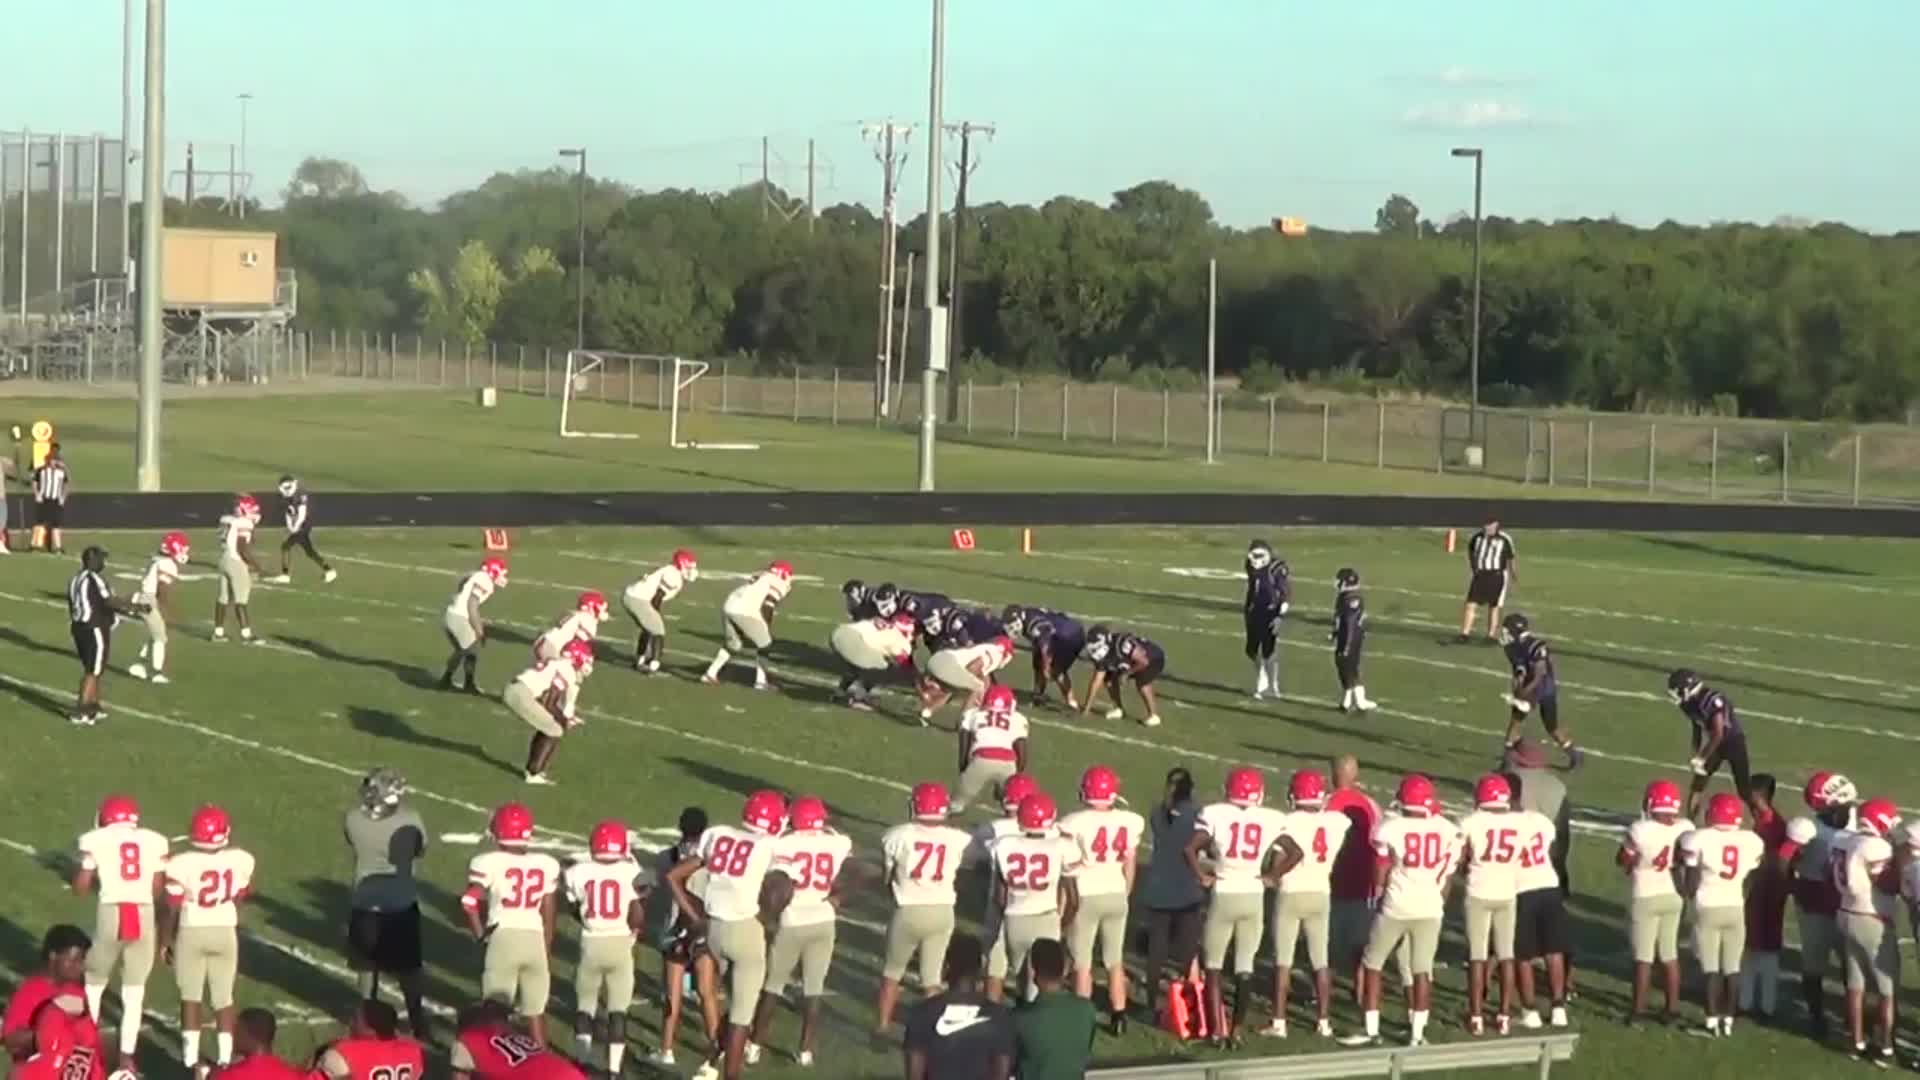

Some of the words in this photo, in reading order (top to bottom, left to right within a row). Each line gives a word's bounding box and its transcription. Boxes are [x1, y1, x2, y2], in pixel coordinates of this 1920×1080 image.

[707, 836, 754, 877] 88
[1091, 826, 1129, 863] 44
[1225, 822, 1262, 860] 19
[1312, 827, 1329, 863] 4
[1402, 832, 1441, 869] 80
[1480, 828, 1518, 863] 15
[120, 842, 140, 881] 8
[792, 852, 834, 890] 39
[910, 842, 947, 881] 71
[1006, 853, 1050, 891] 22
[1719, 845, 1740, 880] 9
[198, 868, 233, 908] 21
[501, 867, 545, 909] 32
[585, 879, 621, 920] 10
